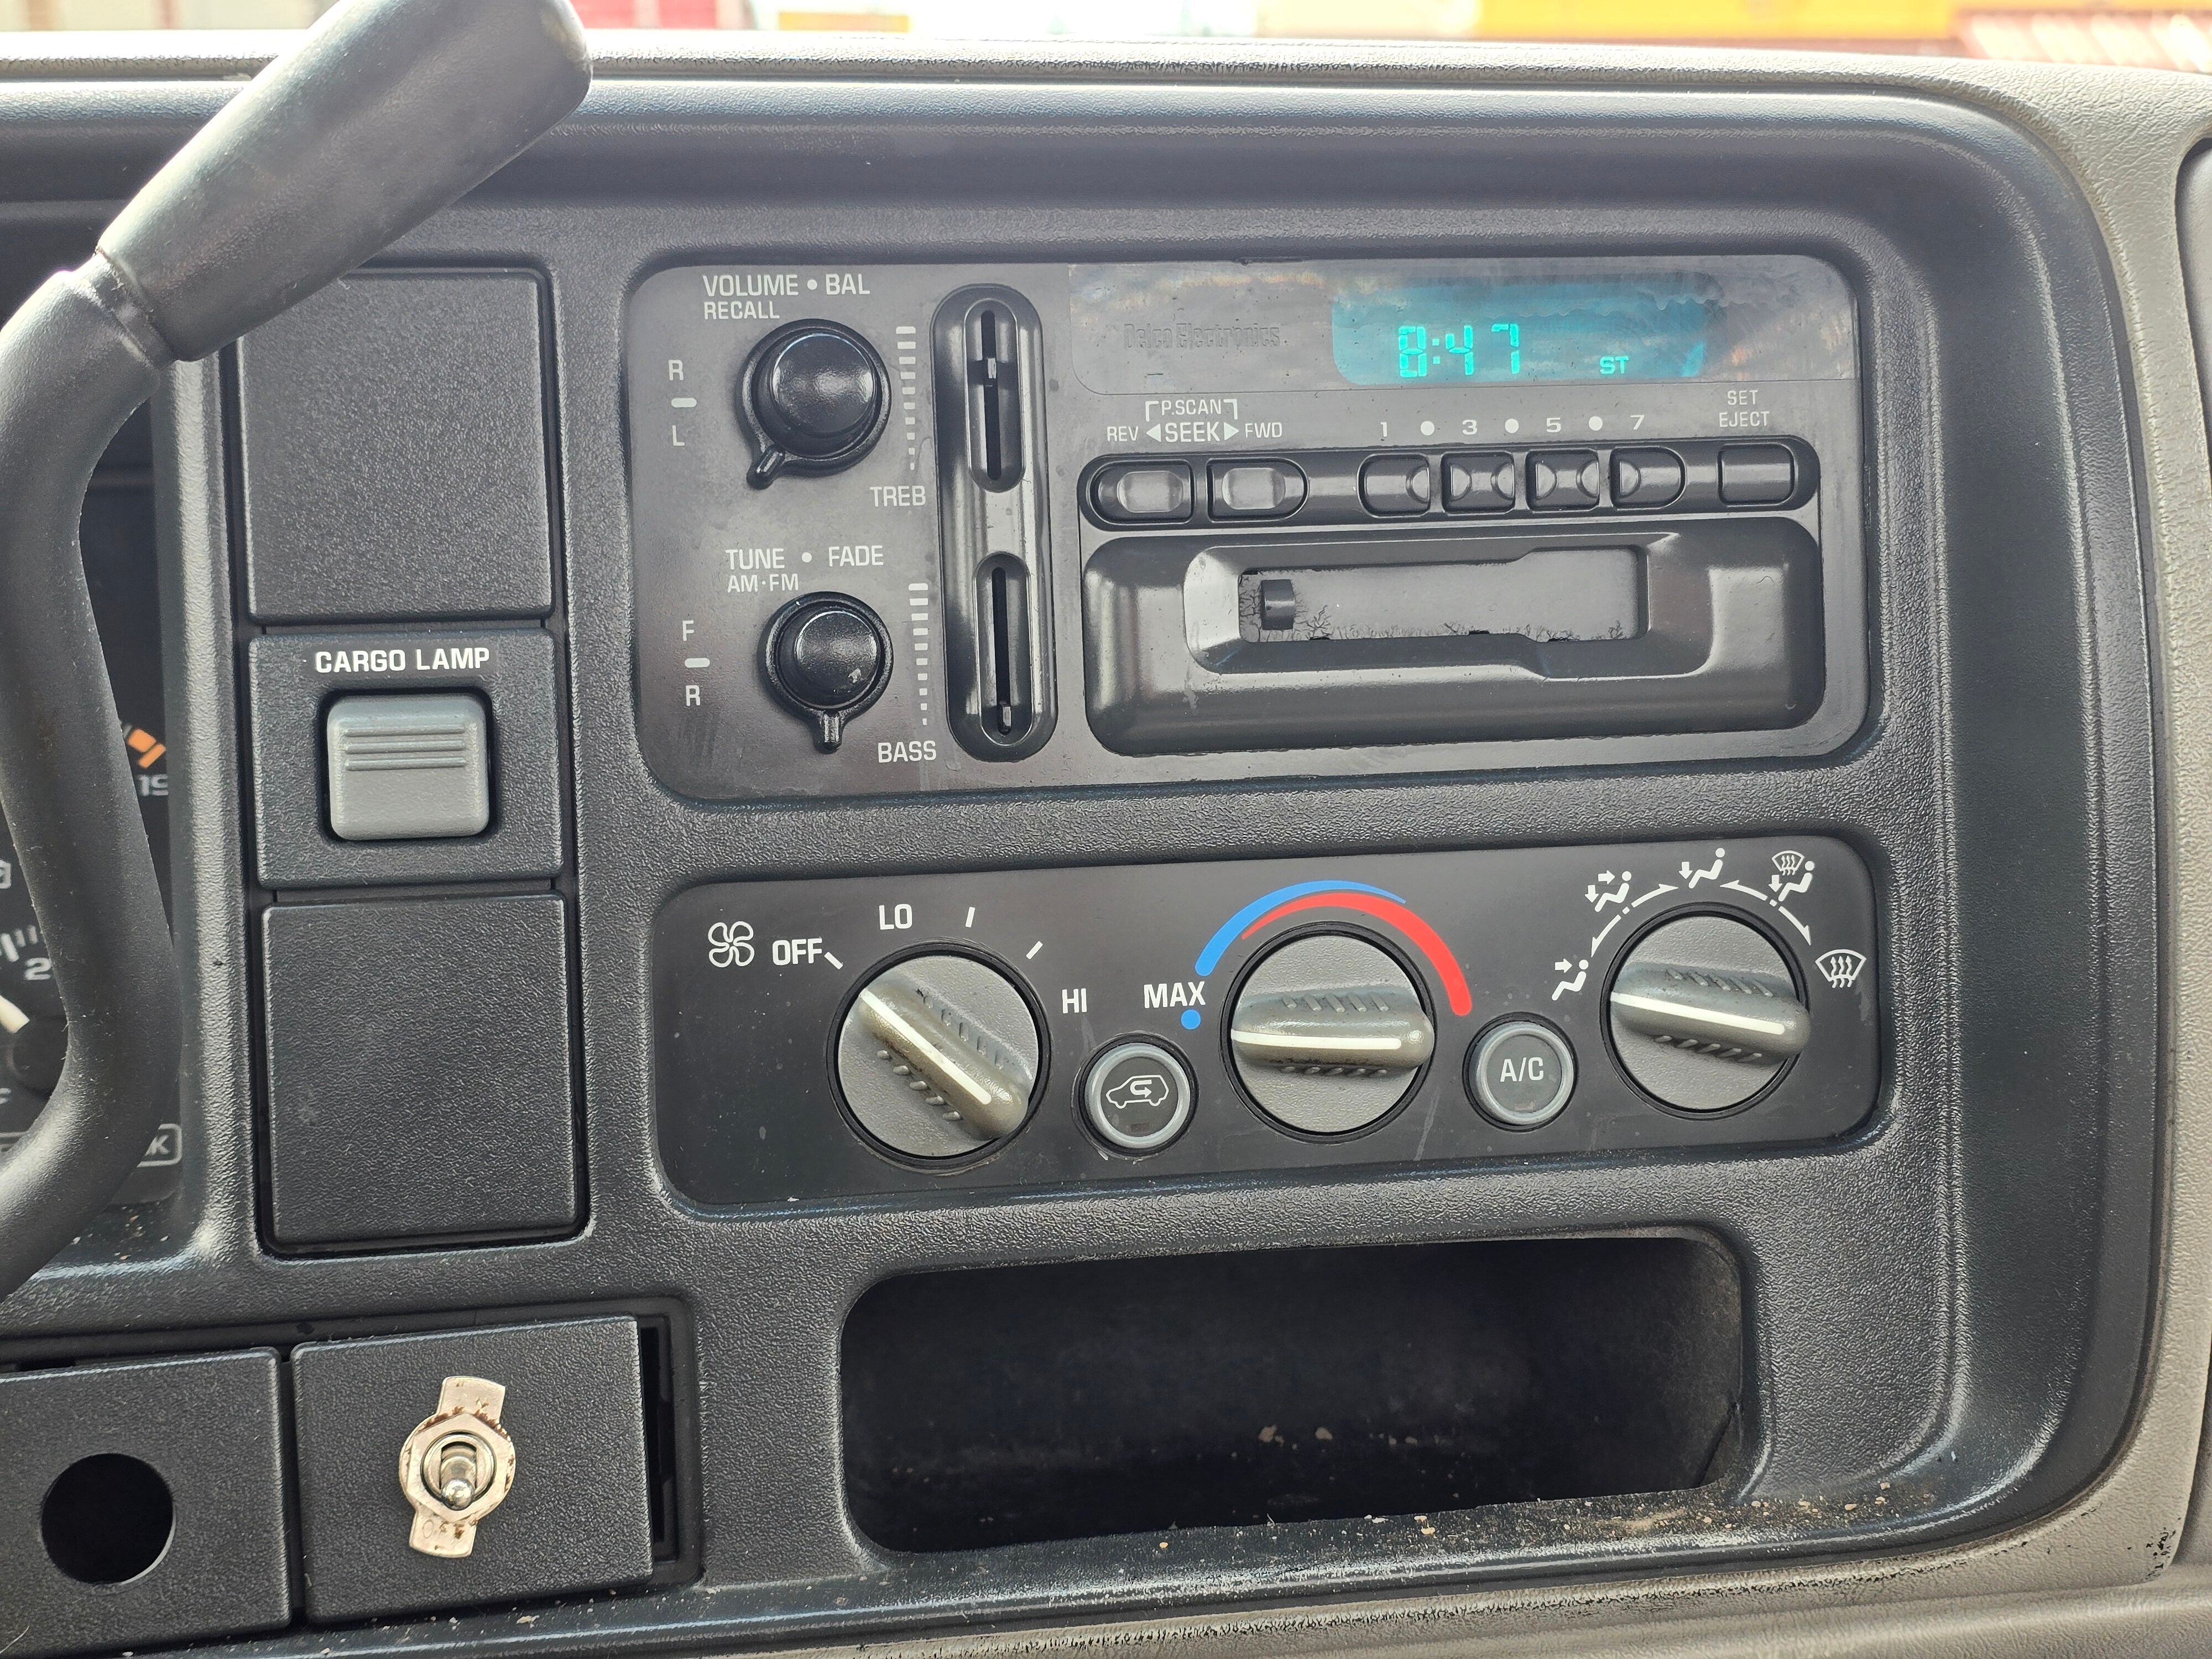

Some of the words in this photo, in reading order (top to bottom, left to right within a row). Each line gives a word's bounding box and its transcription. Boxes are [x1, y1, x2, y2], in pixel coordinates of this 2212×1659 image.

[703, 274, 799, 296] VOLUME
[826, 274, 870, 295] BAL
[705, 301, 780, 319] RECALL
[1124, 323, 1173, 349] Delco
[1176, 322, 1280, 349] Electronics
[1399, 323, 1520, 378] 8:47
[1599, 356, 1629, 374] ST
[669, 359, 684, 380] R
[1162, 399, 1221, 415] P.SCAN
[1728, 390, 1758, 405] SET
[1380, 421, 1387, 437] 1
[1463, 420, 1477, 435] 3
[1547, 418, 1561, 432] 5
[1630, 415, 1644, 430] 7
[1719, 411, 1770, 427] EJECT
[672, 425, 685, 446] L
[1107, 426, 1138, 441] REV
[1165, 422, 1220, 442] SEEK
[1245, 422, 1282, 438] FWD
[870, 486, 926, 507] TREB
[726, 549, 785, 570] TUNE
[829, 545, 883, 566] FADE
[682, 619, 694, 641] F
[315, 650, 405, 673] CARGO
[416, 648, 489, 670] LAMP
[686, 685, 700, 706] R
[878, 740, 936, 763] BASS
[879, 904, 912, 930] LO
[773, 938, 822, 965] OFF
[1062, 988, 1087, 1013] HI
[1144, 982, 1206, 1008] MAX
[1500, 1057, 1543, 1082] A/C
